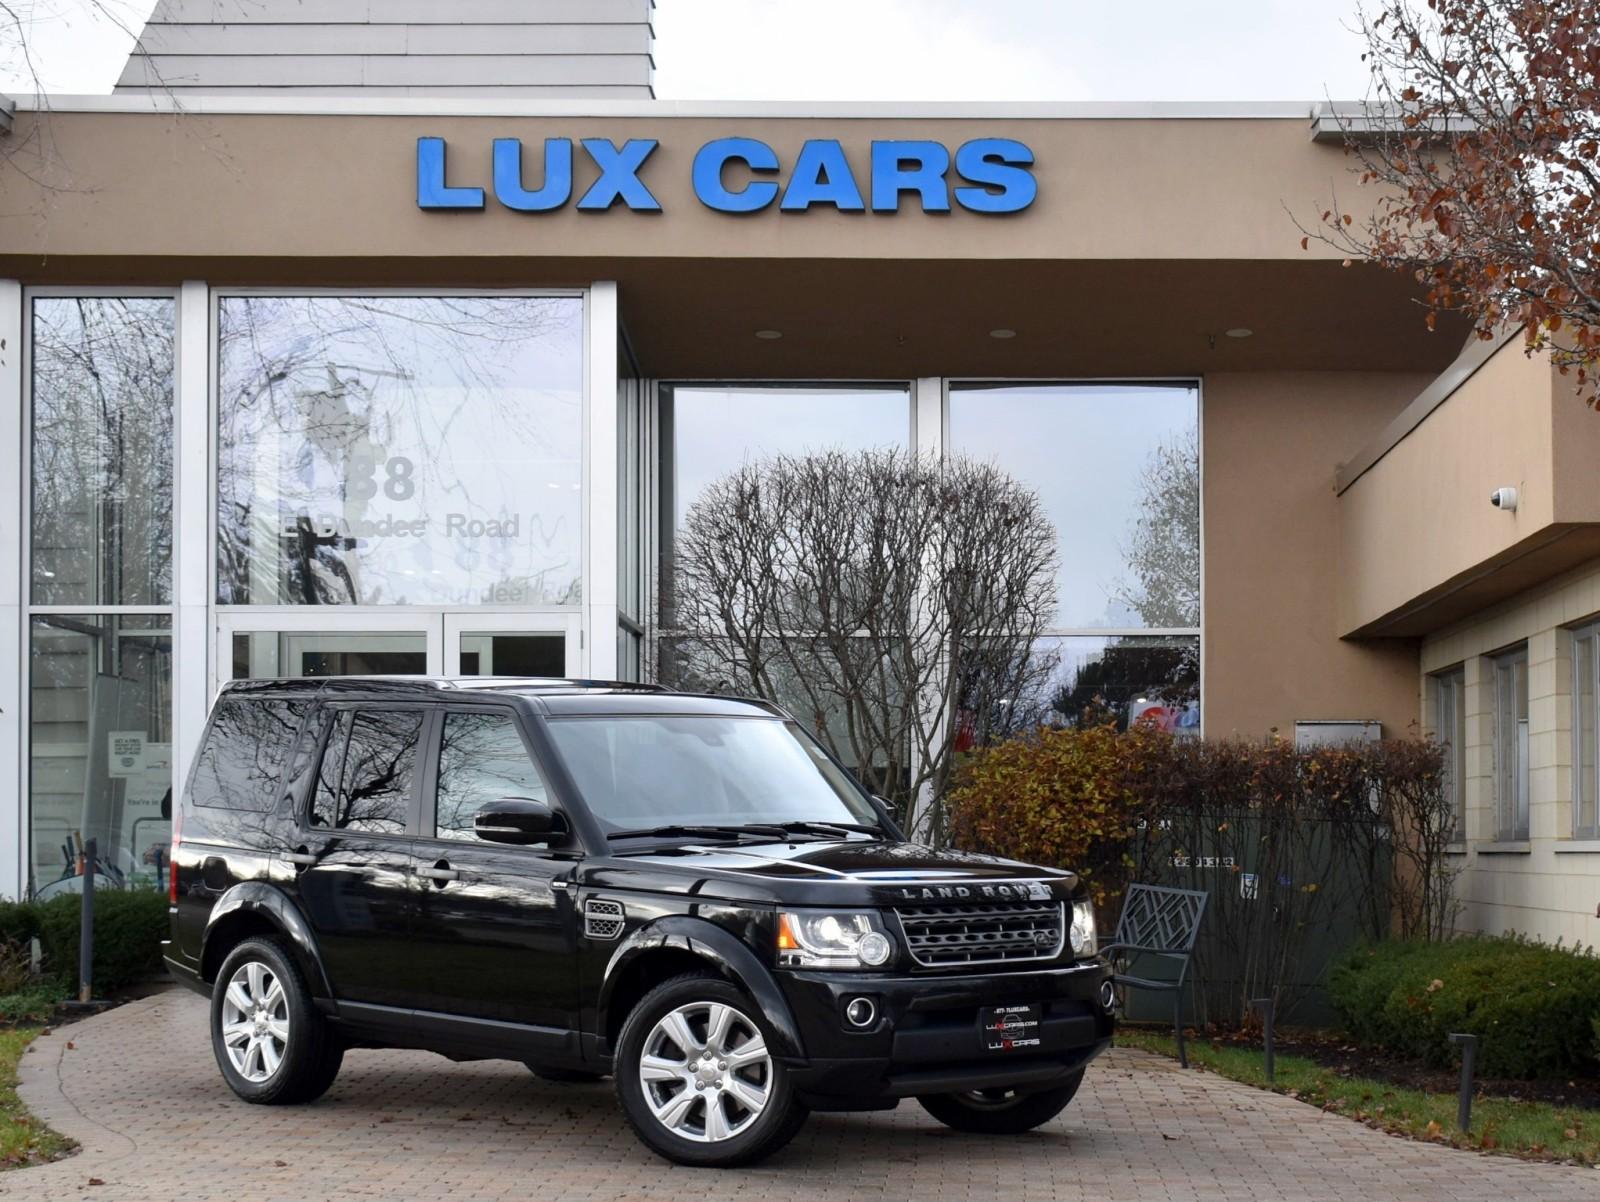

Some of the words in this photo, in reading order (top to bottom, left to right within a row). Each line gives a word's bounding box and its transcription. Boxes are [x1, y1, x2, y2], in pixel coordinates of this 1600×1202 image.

[417, 137, 662, 214] LUX
[692, 137, 1038, 214] CARS
[446, 513, 519, 538] Road
[902, 887, 970, 899] LAND
[983, 884, 1053, 897] ROVER
